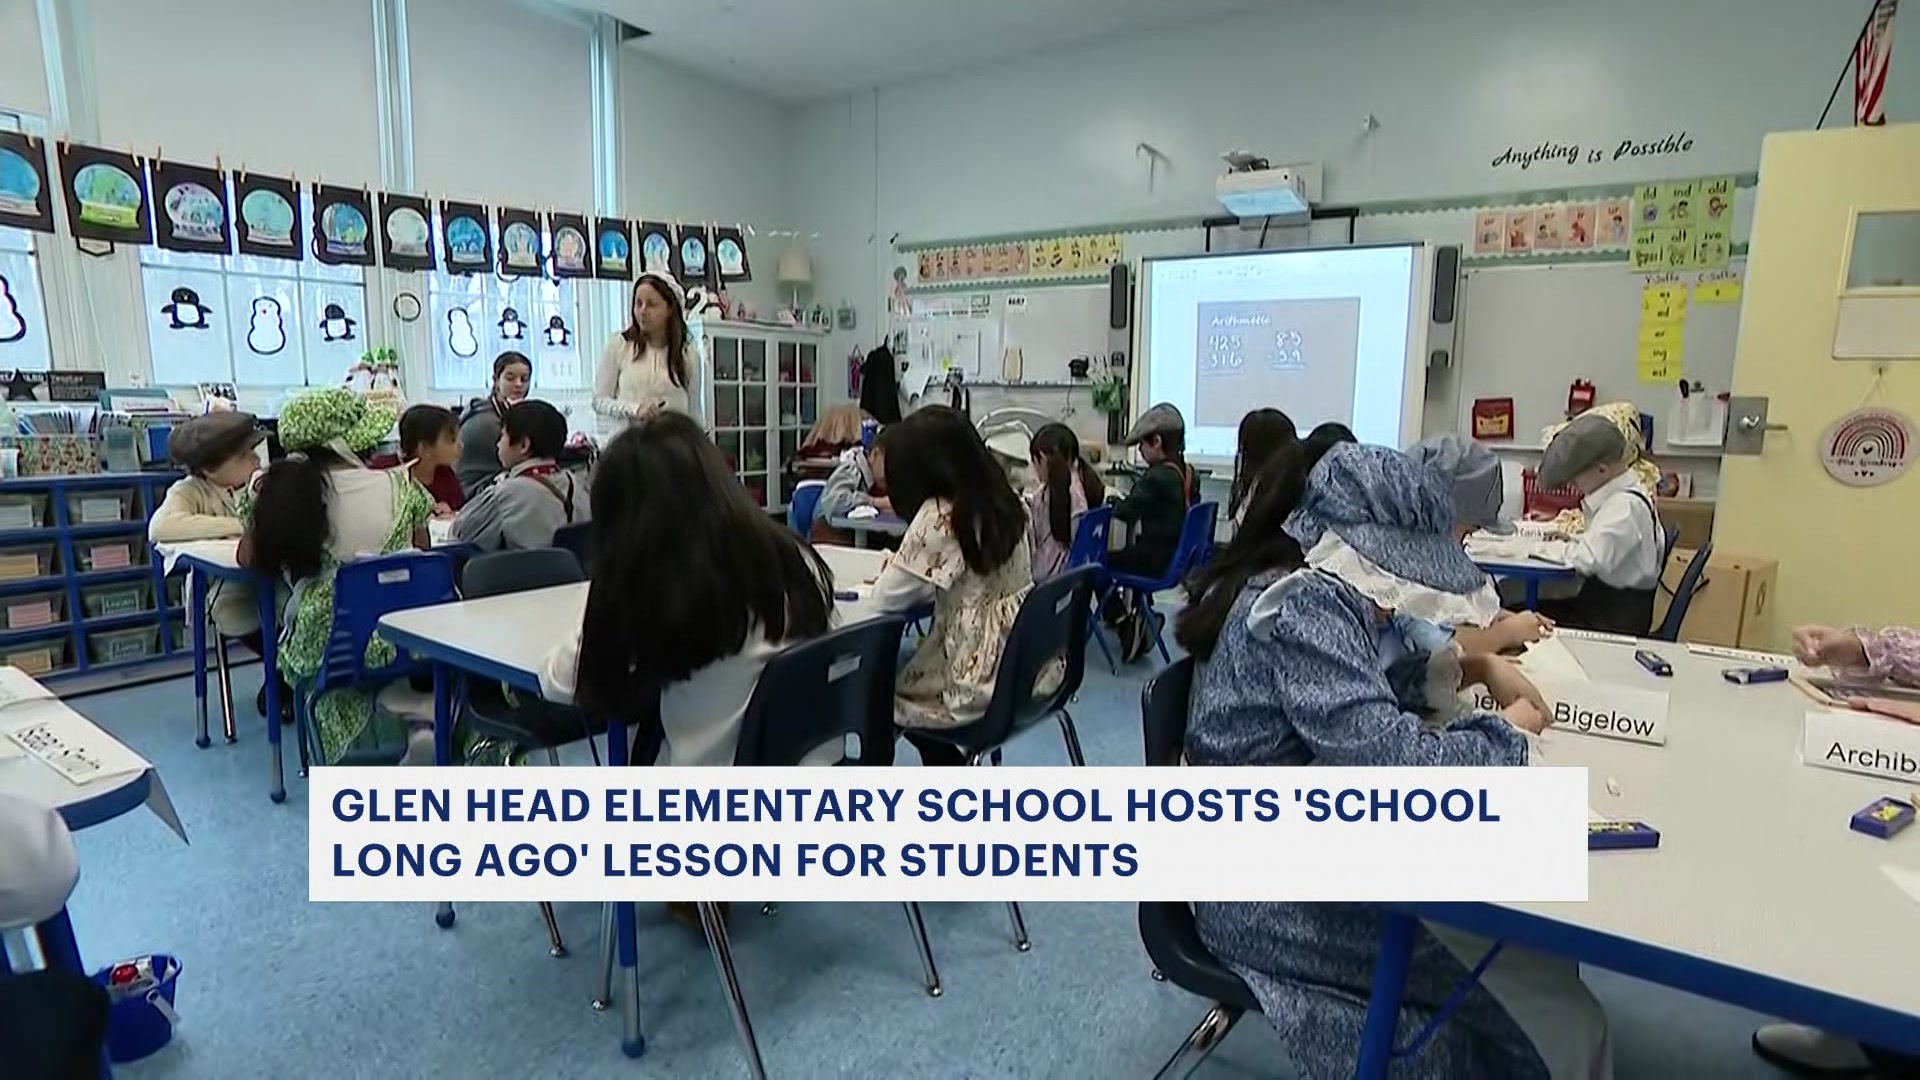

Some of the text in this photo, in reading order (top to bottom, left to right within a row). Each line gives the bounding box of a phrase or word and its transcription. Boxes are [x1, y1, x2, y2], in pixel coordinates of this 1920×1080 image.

[1491, 131, 1694, 170] Anything is Possible
[1554, 701, 1655, 737] Bigelow
[1826, 741, 1920, 774] Archib
